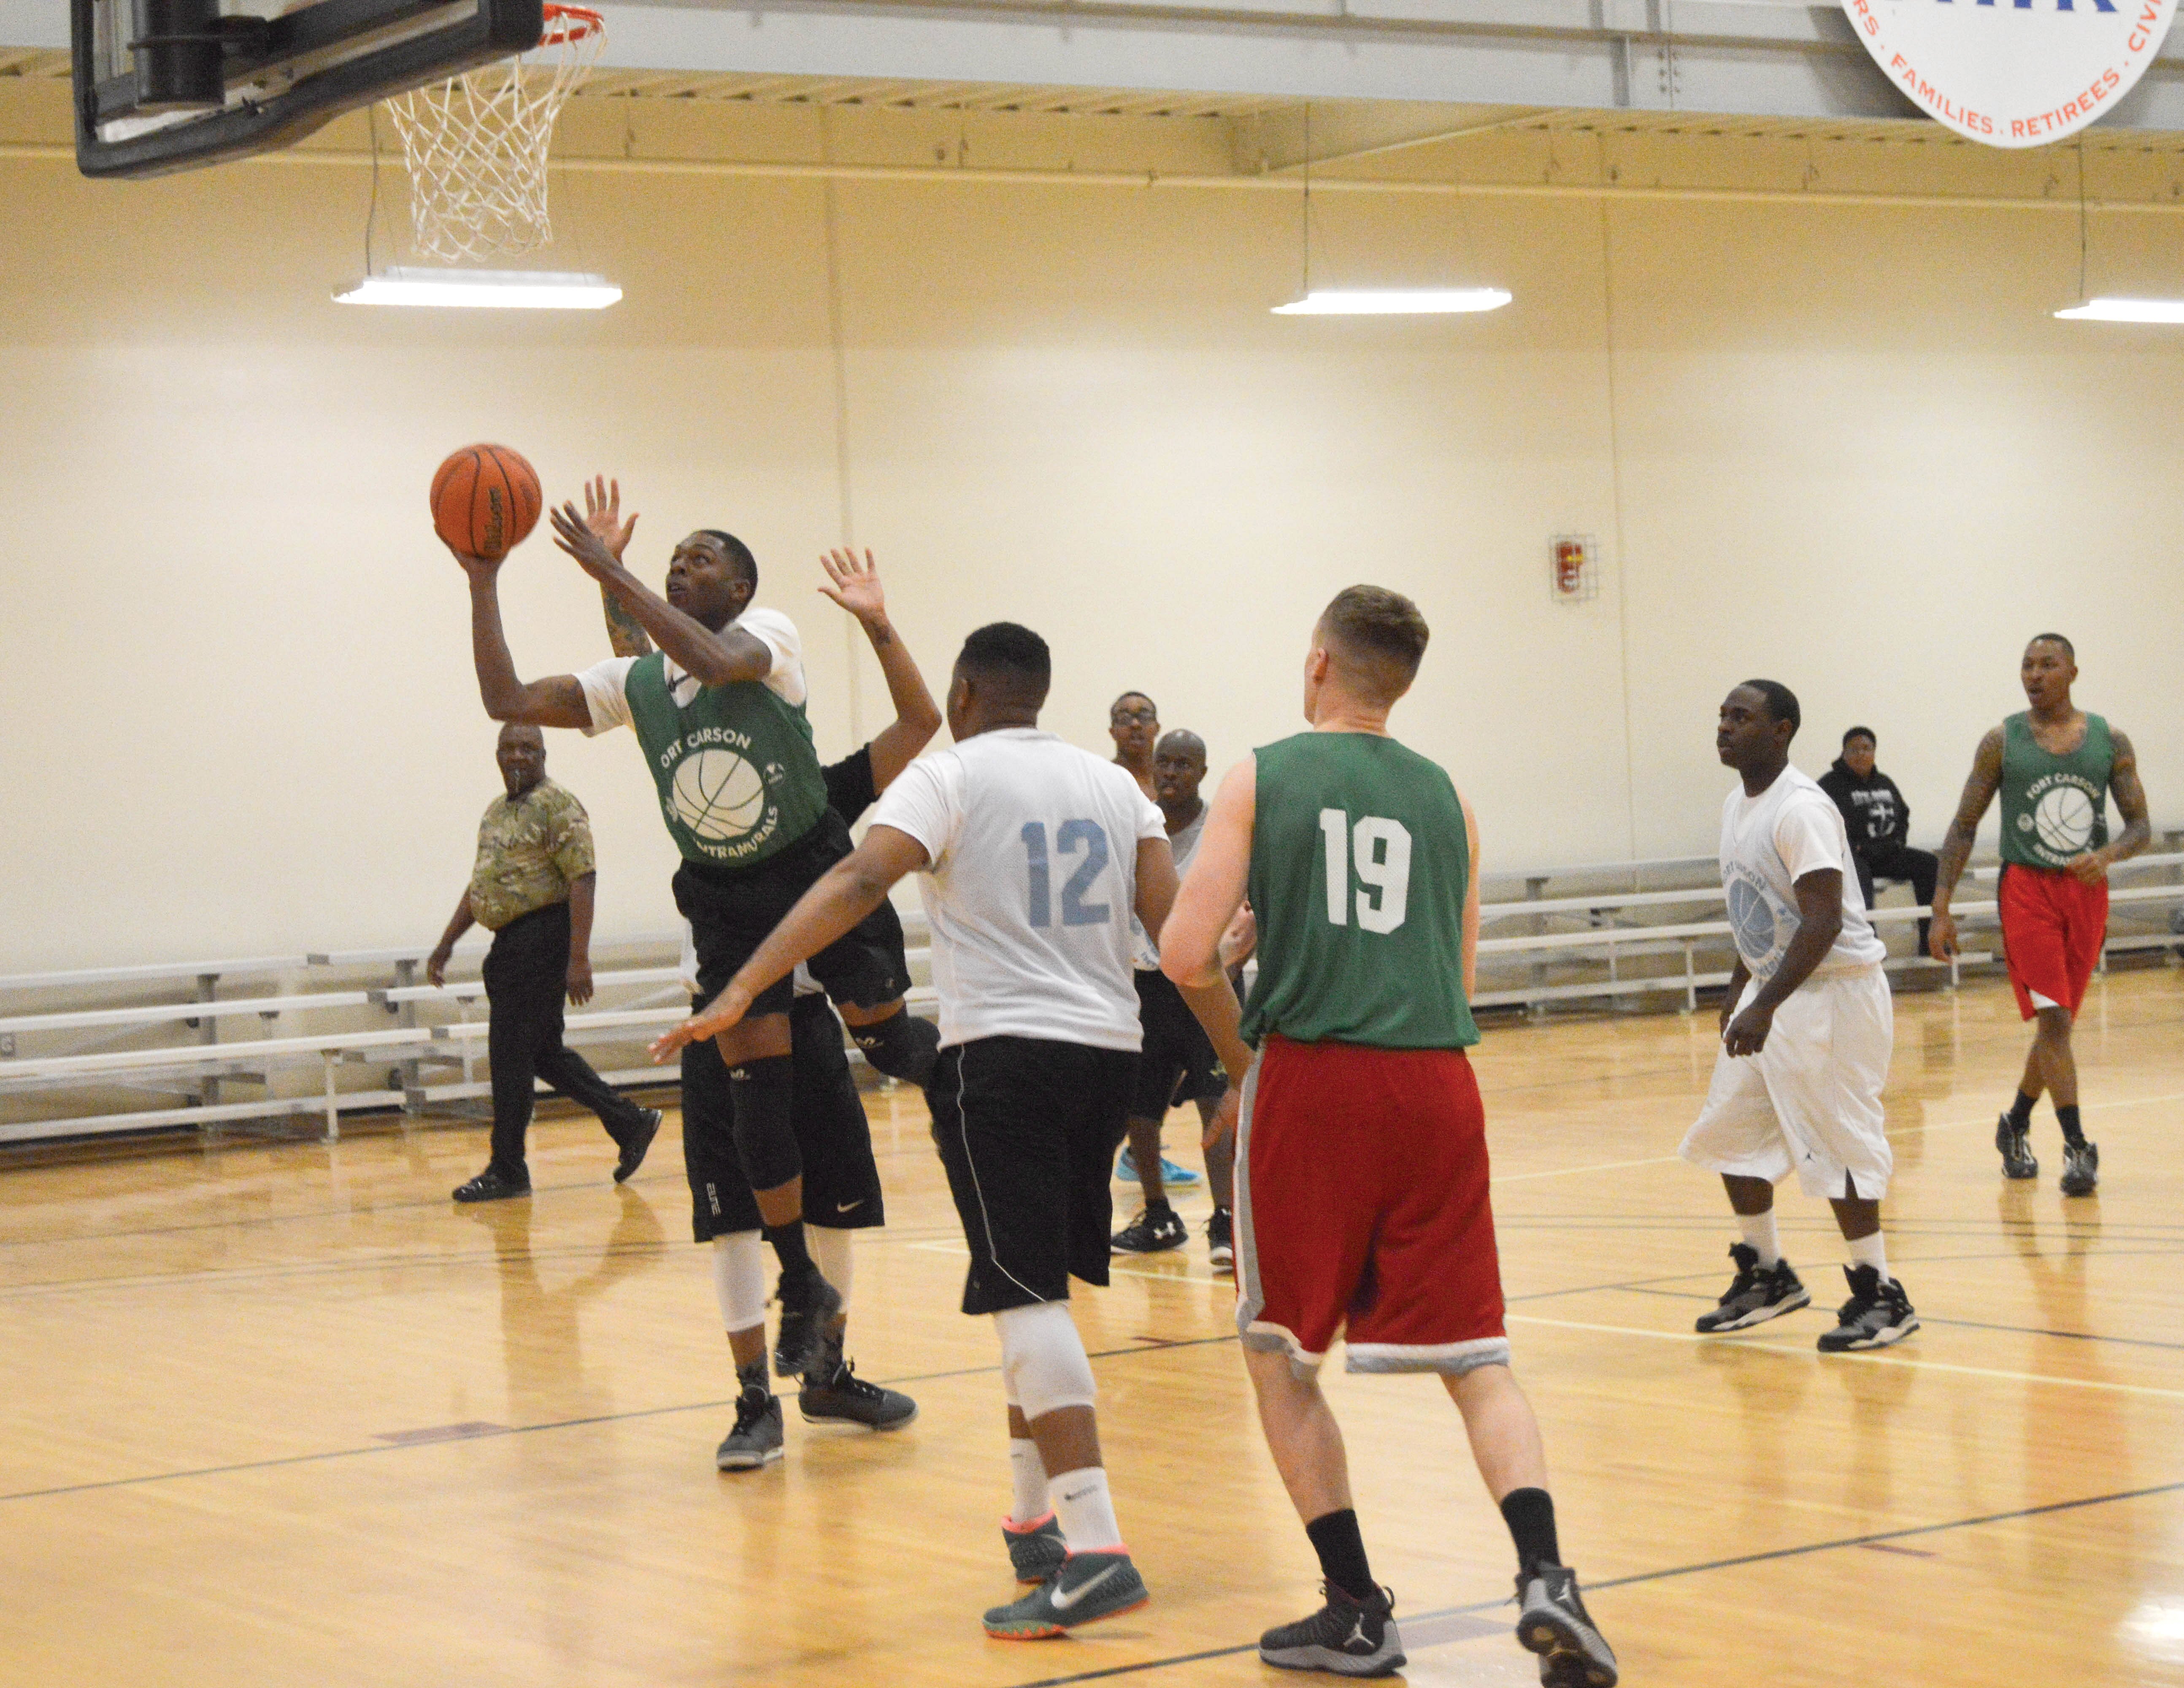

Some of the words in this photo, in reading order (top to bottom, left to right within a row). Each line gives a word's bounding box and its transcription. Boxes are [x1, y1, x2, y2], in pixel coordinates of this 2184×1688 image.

[1890, 52, 1993, 135] FAMILIES
[2011, 68, 2120, 138] RETIREES
[660, 738, 683, 768] ORT
[687, 726, 752, 750] CARSON
[1021, 818, 1111, 928] 12
[1319, 807, 1412, 935] 19
